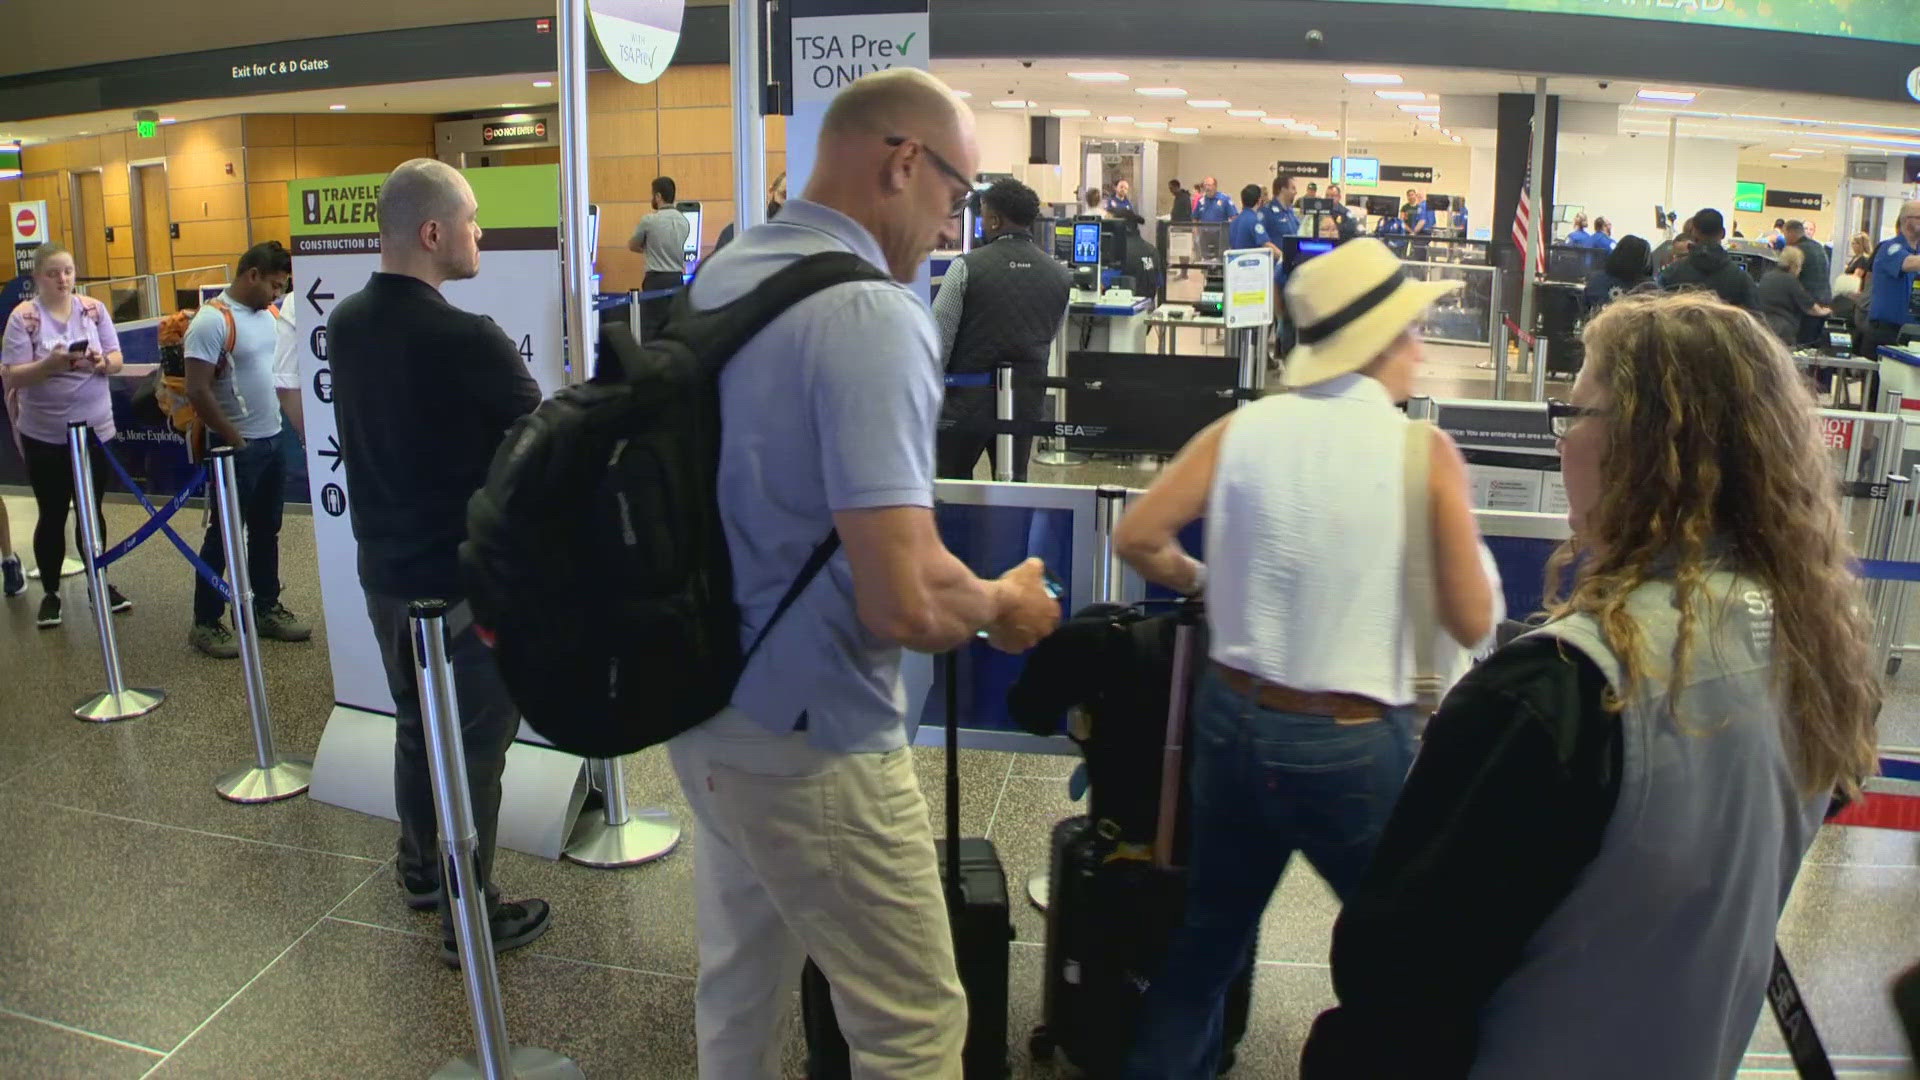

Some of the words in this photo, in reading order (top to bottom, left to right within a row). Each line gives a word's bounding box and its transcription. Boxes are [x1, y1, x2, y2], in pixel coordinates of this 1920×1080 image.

[619, 44, 635, 65] TSA
[795, 35, 844, 60] TSA
[851, 34, 893, 58] Pre
[232, 65, 251, 78] Exit
[253, 63, 267, 76] for
[269, 62, 277, 74] C
[279, 61, 287, 73] &
[289, 60, 297, 72] D
[299, 59, 329, 71] Gates
[493, 128, 504, 137] DO
[504, 127, 517, 136] NOT
[517, 126, 535, 136] ENTER
[322, 185, 380, 202] TRAVELE
[323, 202, 377, 225] ALER
[300, 238, 365, 250] CONSTRUCTION
[367, 238, 380, 248] DE
[126, 429, 145, 440] More
[147, 430, 185, 445] Exploring
[1054, 424, 1085, 436] SEA
[1466, 429, 1479, 437] You
[1490, 431, 1517, 439] entering
[1823, 434, 1845, 449] ER
[1870, 486, 1888, 497] SE
